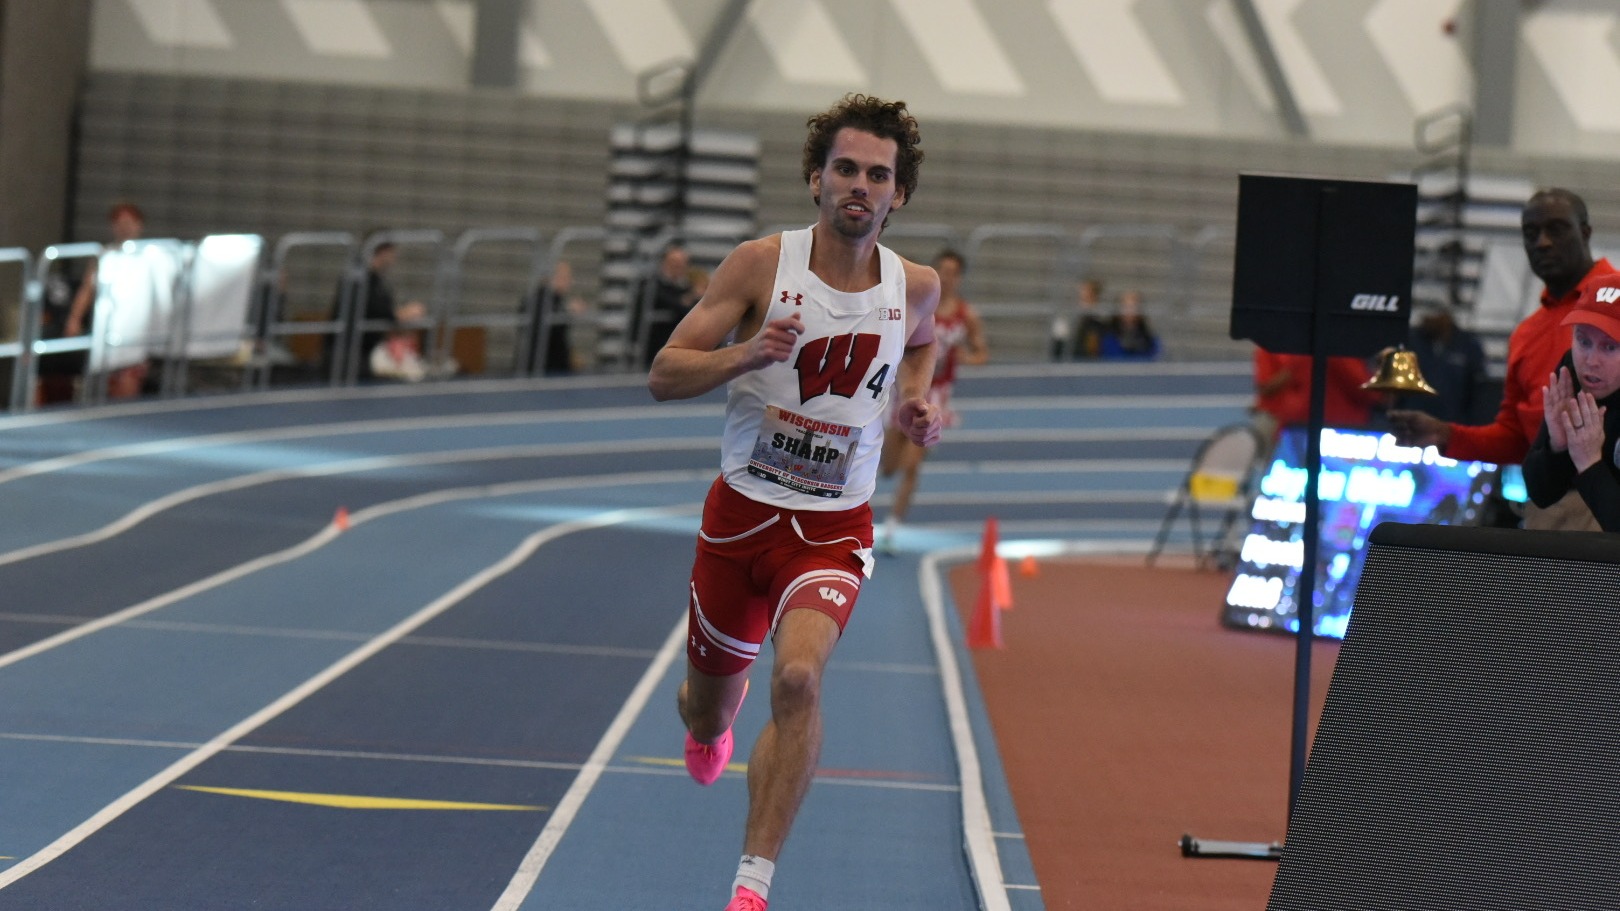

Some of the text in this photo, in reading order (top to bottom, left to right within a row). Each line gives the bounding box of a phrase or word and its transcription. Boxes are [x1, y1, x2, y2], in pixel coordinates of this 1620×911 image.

[1350, 293, 1399, 311] GILL
[793, 333, 881, 405] W
[866, 363, 890, 399] 4
[778, 409, 851, 437] WISCONSIN
[771, 432, 839, 464] SHARP
[749, 460, 782, 475] UNIVERSITY
[790, 475, 820, 487] WISCONSIN
